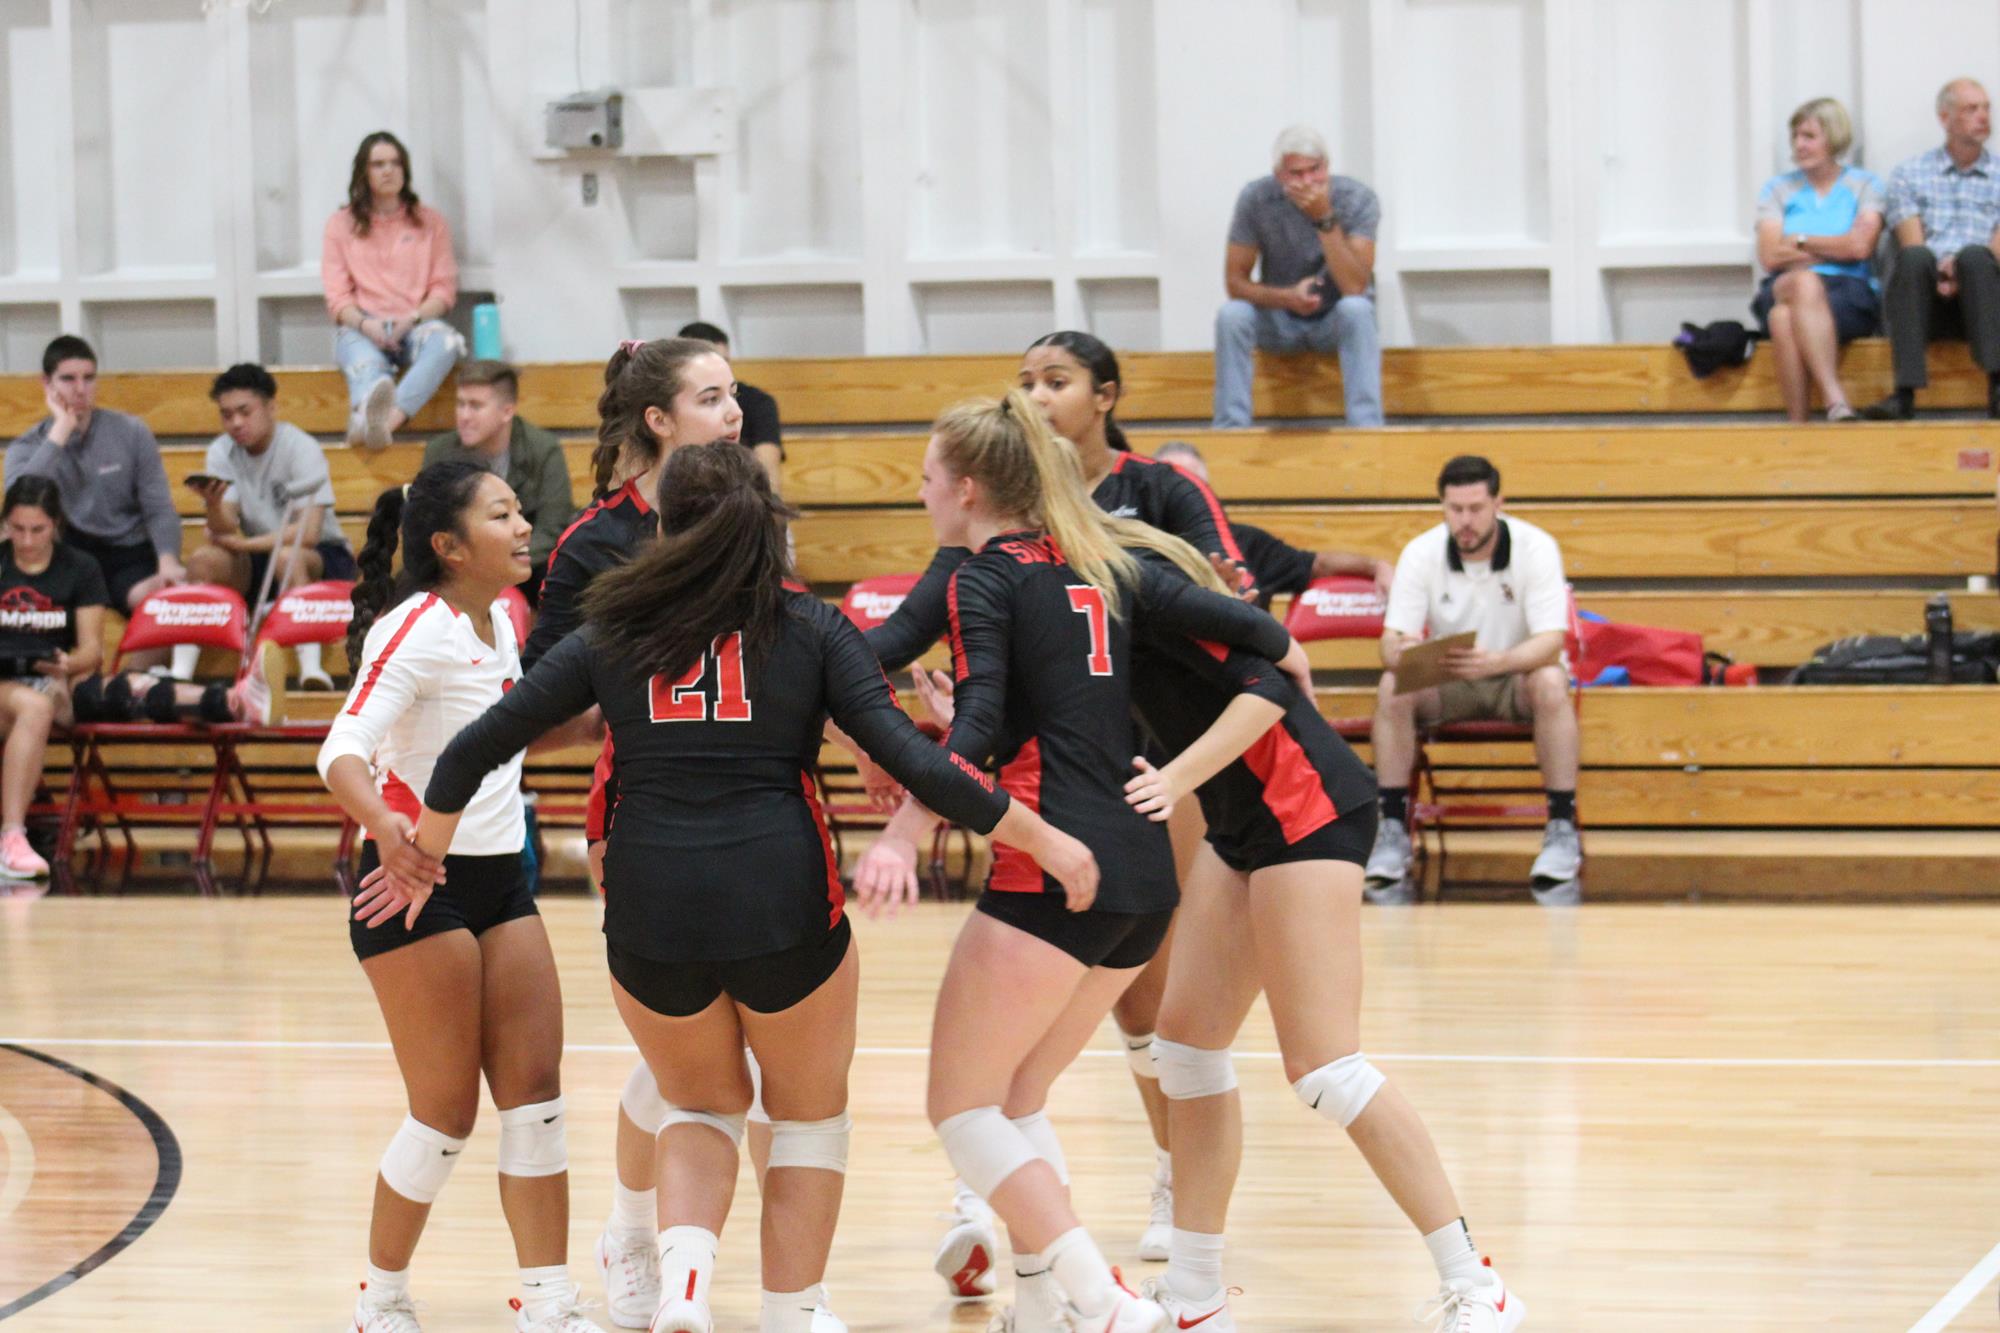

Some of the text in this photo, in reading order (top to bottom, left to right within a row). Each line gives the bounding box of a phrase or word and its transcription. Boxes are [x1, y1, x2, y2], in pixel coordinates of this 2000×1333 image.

[0, 608, 67, 630] MPSON
[143, 599, 233, 617] Simpson
[155, 614, 232, 627] University
[1065, 584, 1113, 676] 7
[648, 629, 752, 723] 21
